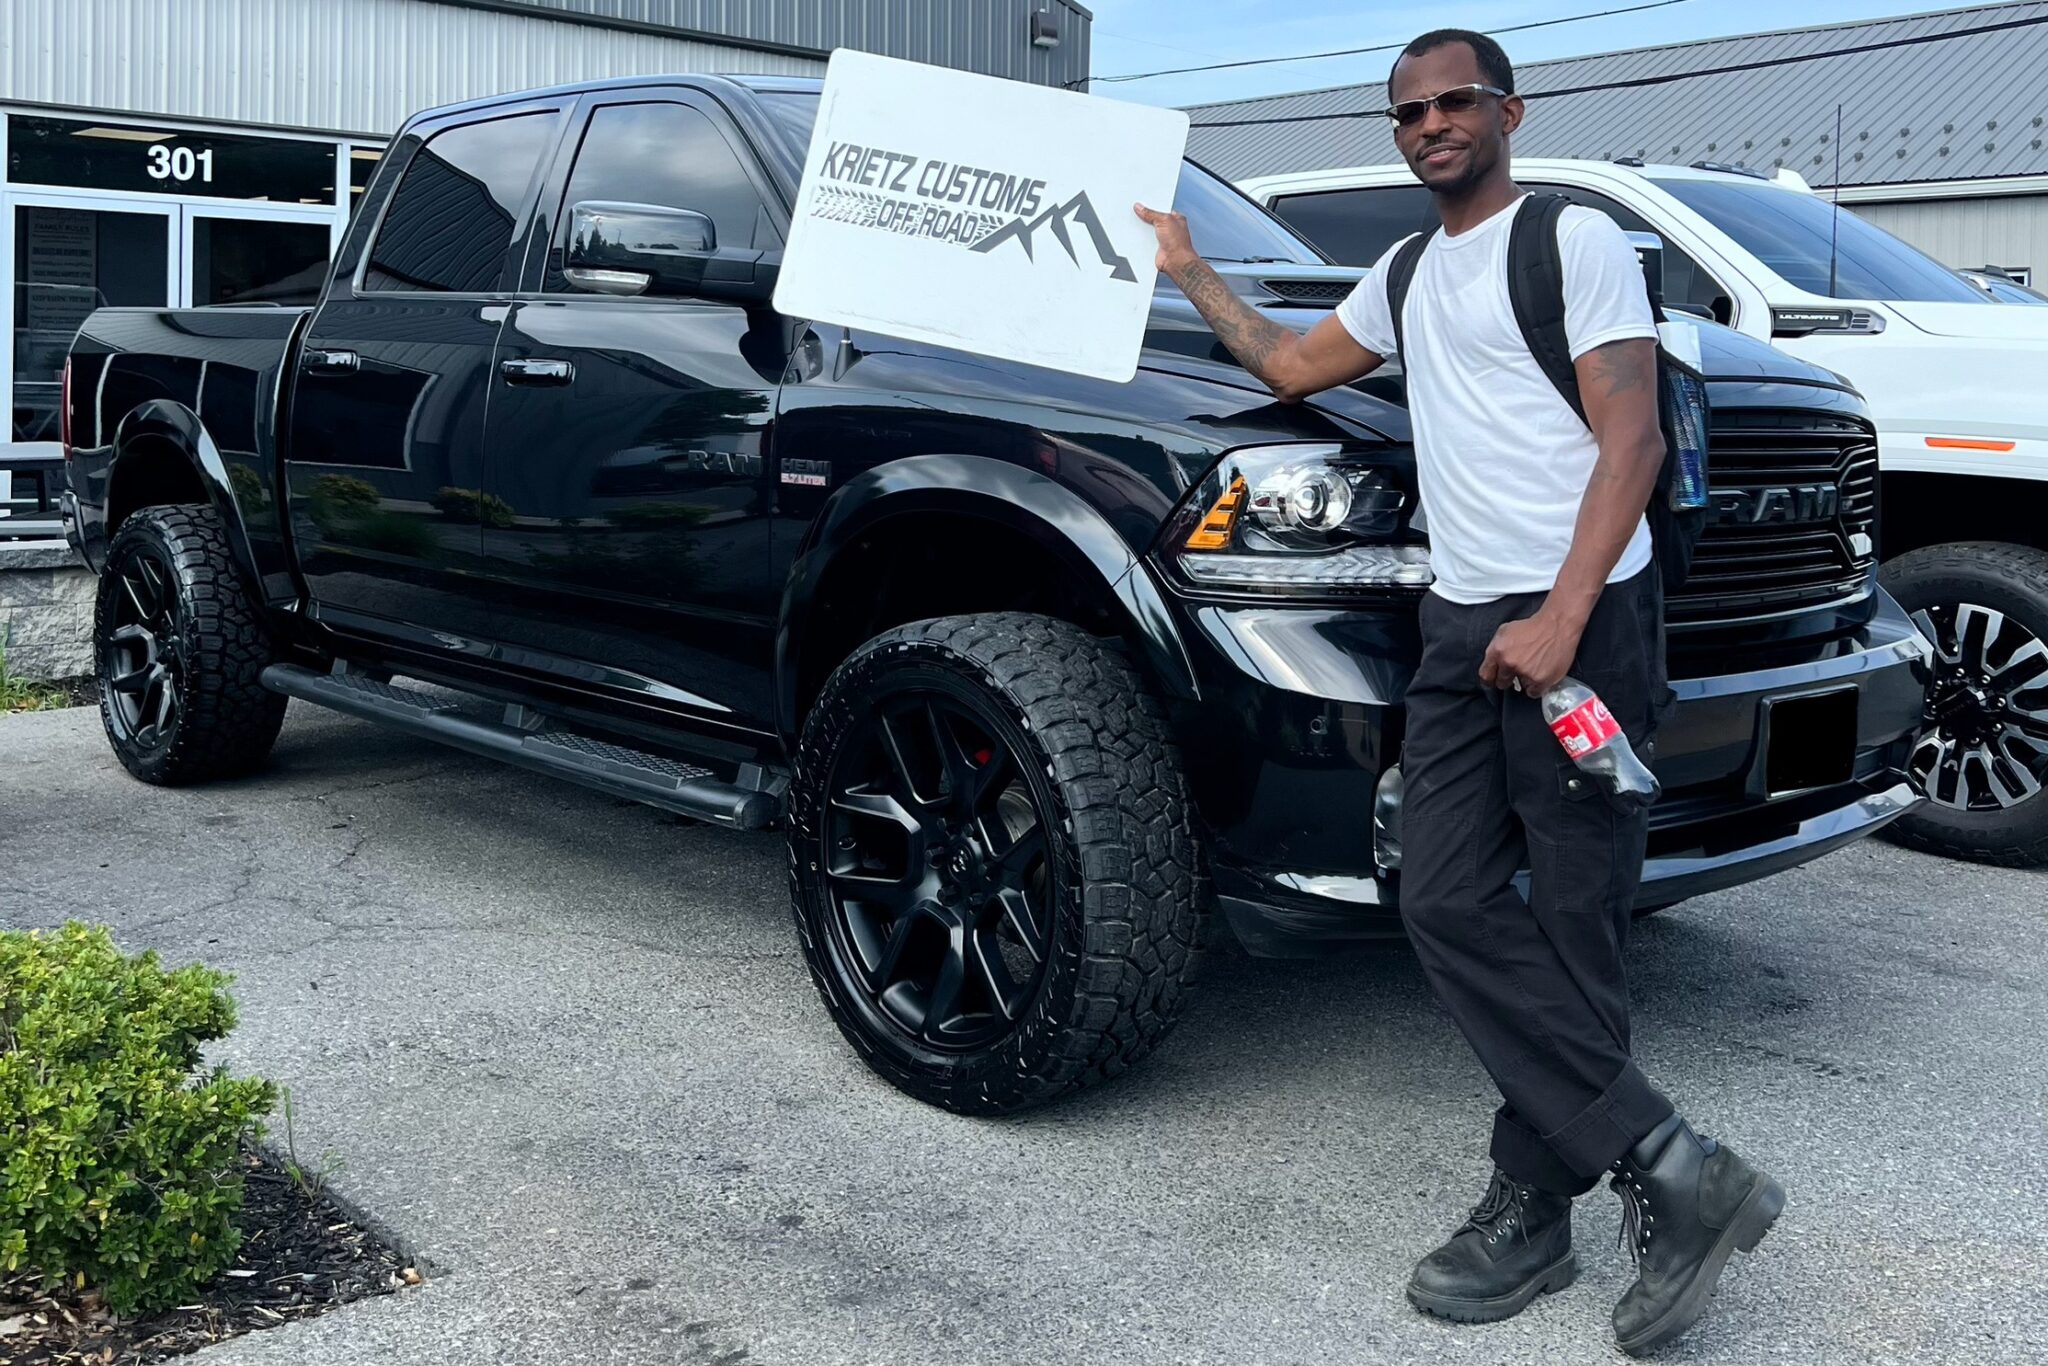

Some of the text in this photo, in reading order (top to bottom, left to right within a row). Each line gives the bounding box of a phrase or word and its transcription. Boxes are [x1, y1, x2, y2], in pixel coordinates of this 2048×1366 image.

[147, 145, 213, 182] 301
[819, 141, 1047, 217] KRIETZ CUSTOMS
[876, 199, 979, 244] OFF ROAD
[689, 449, 763, 476] RAM
[781, 457, 832, 474] HEMI
[797, 475, 826, 486] LITER
[1707, 485, 1838, 524] RAM
